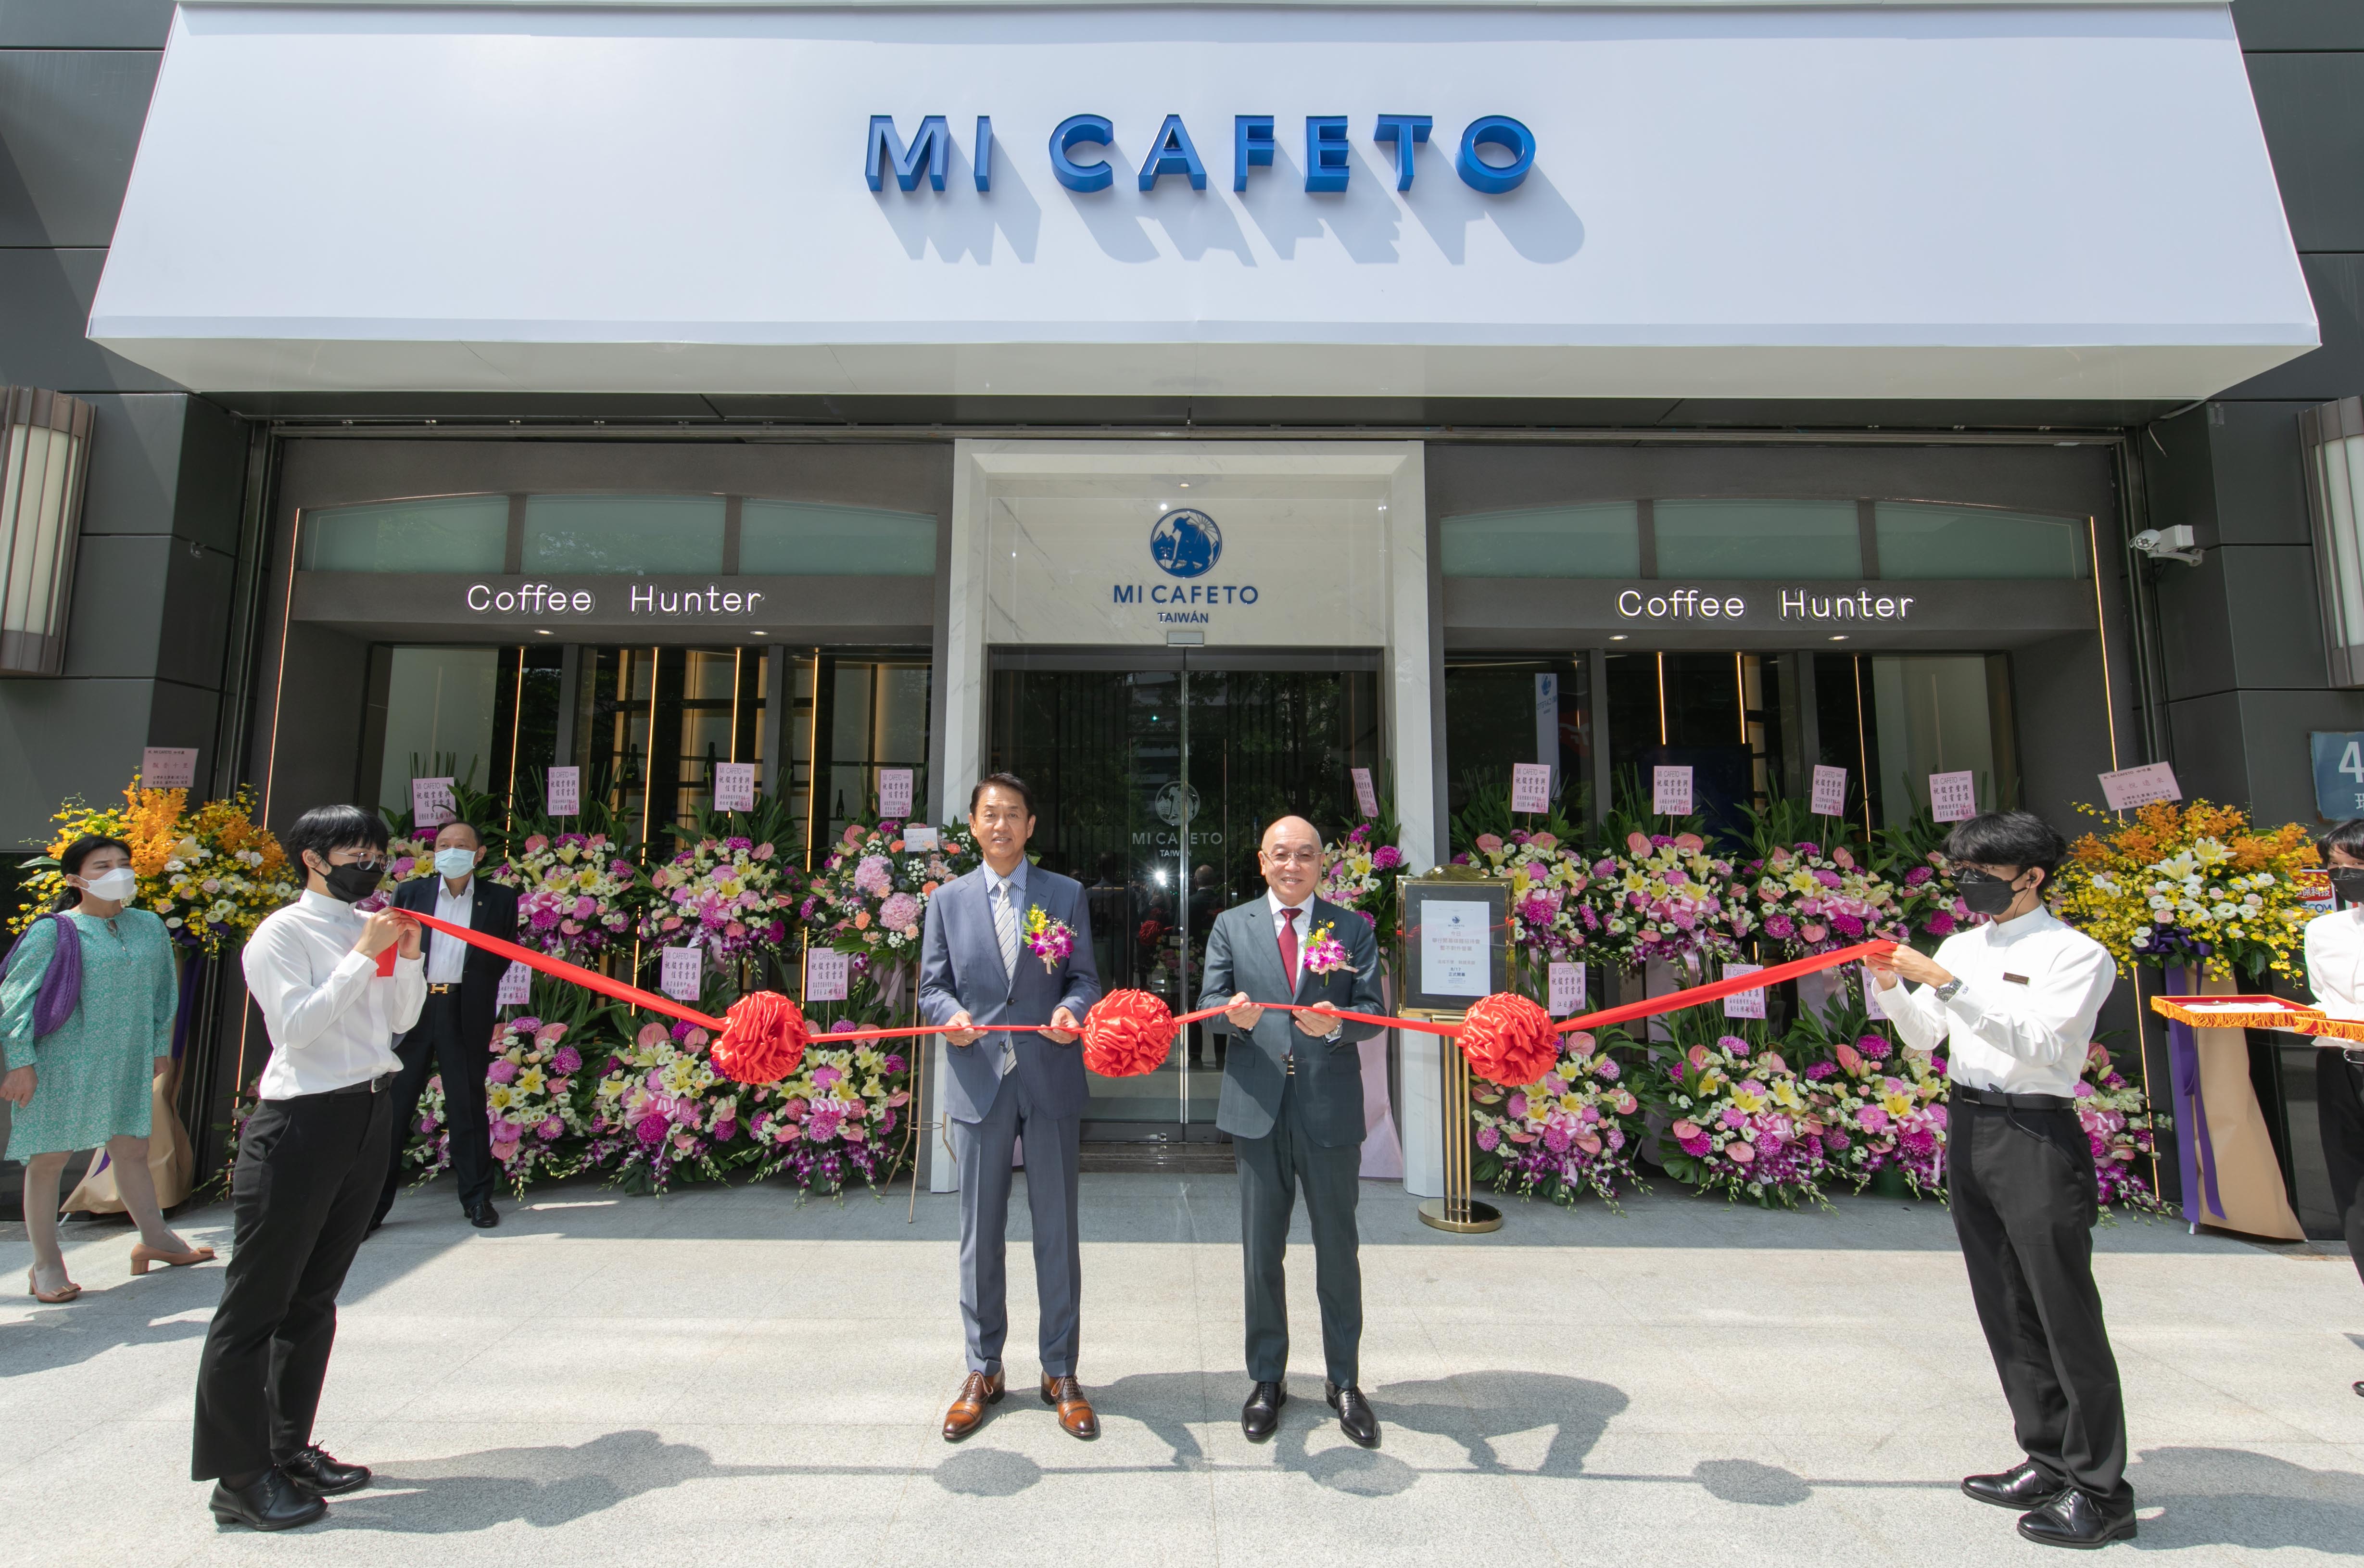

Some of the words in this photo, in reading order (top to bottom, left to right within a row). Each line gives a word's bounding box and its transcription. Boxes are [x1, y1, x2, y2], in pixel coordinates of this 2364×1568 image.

[866, 115, 991, 192] MI
[1048, 114, 1537, 194] CAFETO
[468, 584, 592, 611] Coffee
[632, 585, 761, 612] Hunter
[1114, 585, 1142, 603] MI
[1151, 585, 1258, 605] CAFETO
[1618, 590, 1744, 617] Coffee
[1782, 590, 1913, 617] Hunter
[1158, 610, 1209, 623] TAIWÁN
[1132, 833, 1150, 844] MI
[1156, 833, 1223, 845] CAETO
